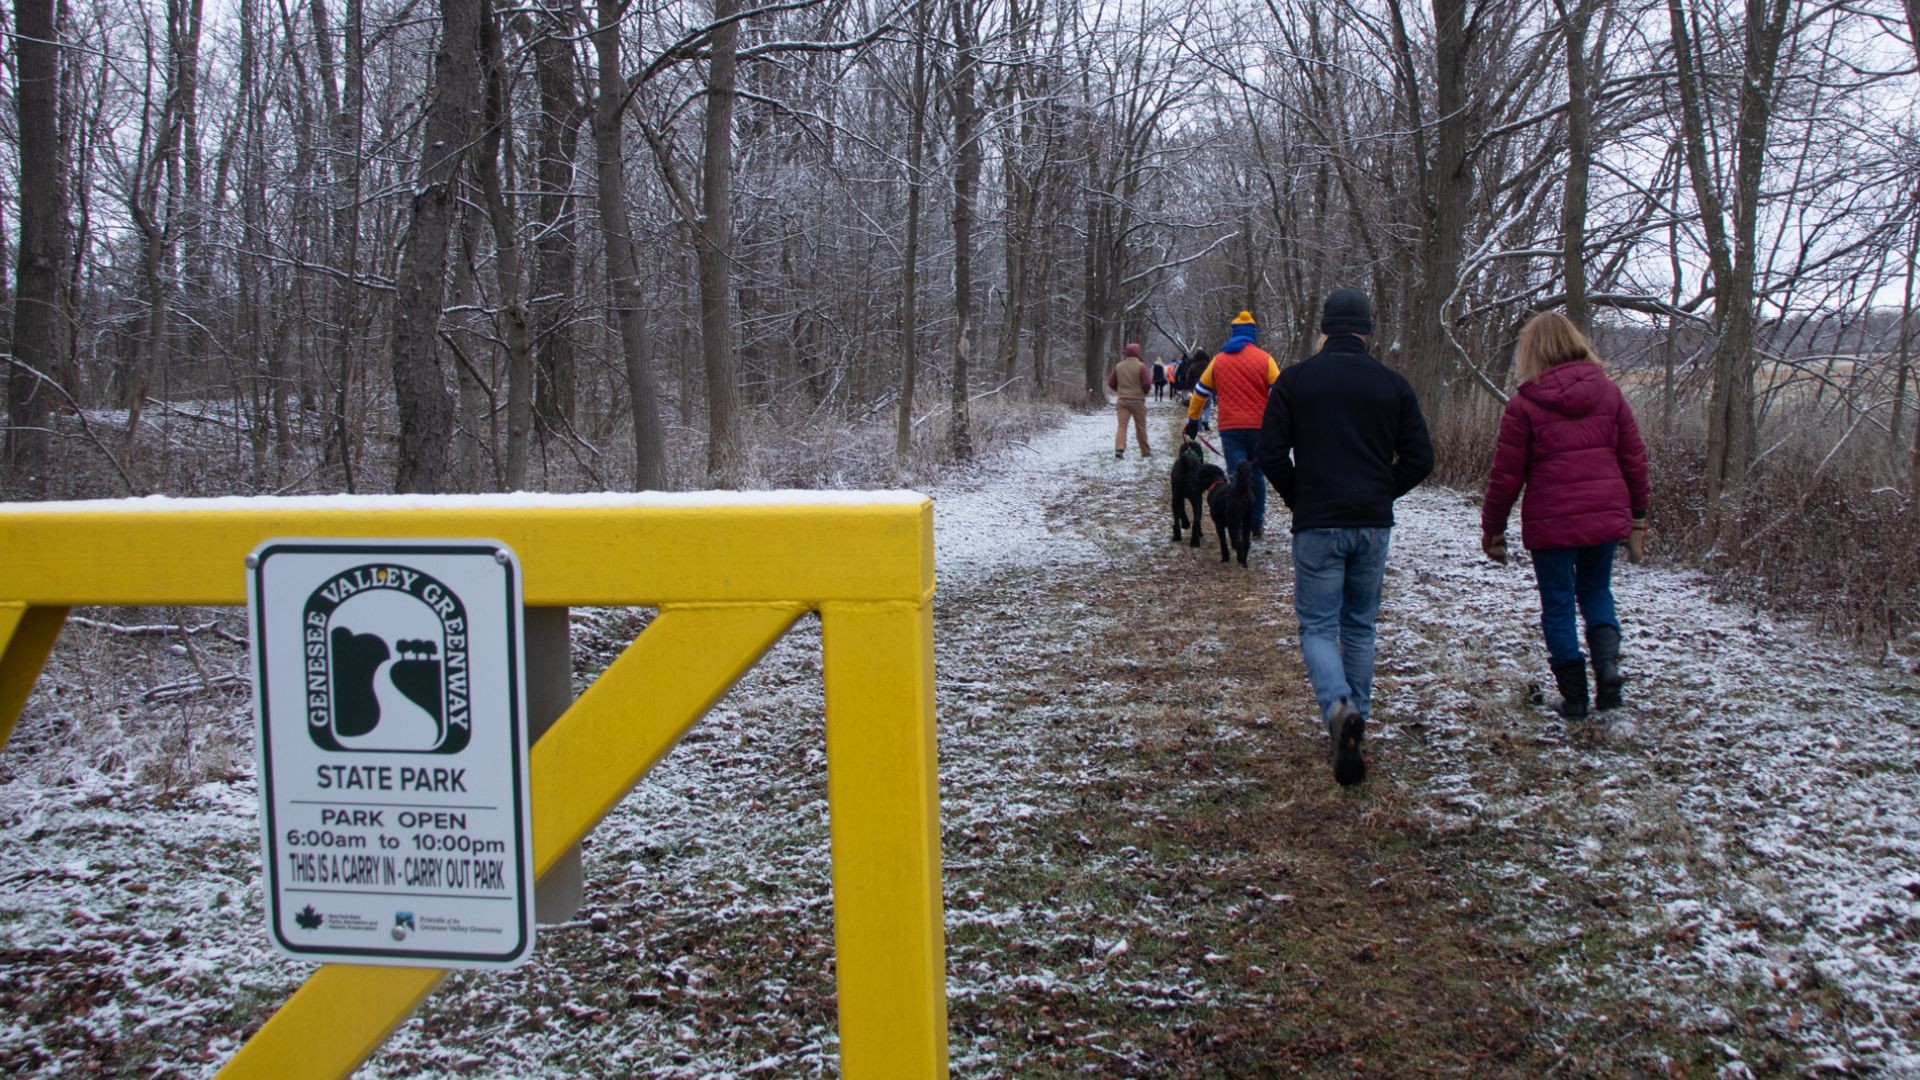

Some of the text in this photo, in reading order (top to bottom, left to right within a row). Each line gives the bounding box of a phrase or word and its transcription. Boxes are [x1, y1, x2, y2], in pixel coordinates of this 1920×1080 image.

[307, 567, 468, 731] GENESEE VALLEY GREENWAY
[316, 764, 467, 793] STATE PARK
[321, 809, 467, 830] PARK OPEN
[286, 829, 505, 856] 6:00am to 10:00pm
[289, 852, 316, 883] THIS
[318, 853, 329, 884] IS
[331, 853, 341, 884] A
[342, 853, 380, 886] CARRY
[382, 855, 396, 886] IN
[404, 856, 443, 888] CARRY
[446, 858, 470, 889] OUT
[473, 859, 505, 890] PARK
